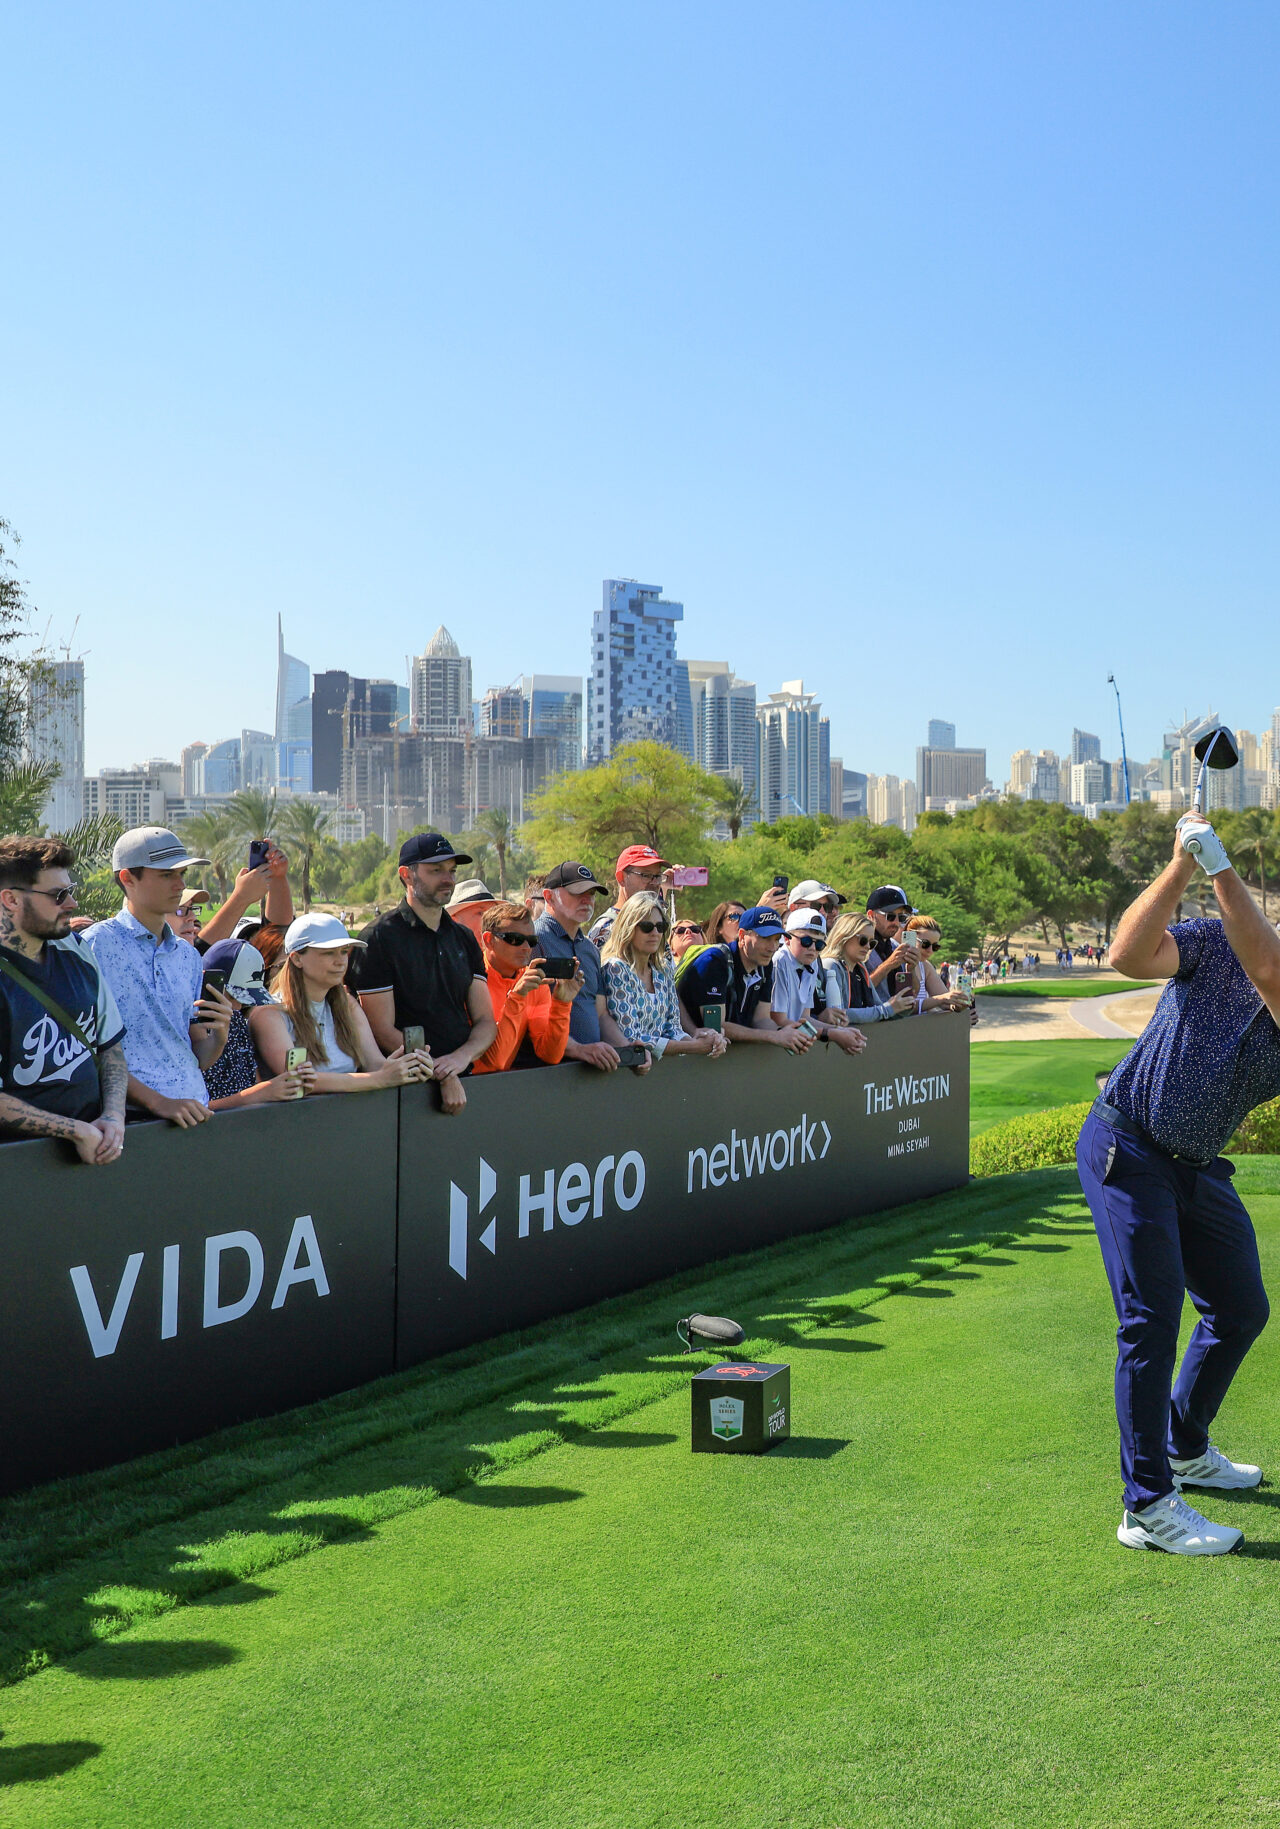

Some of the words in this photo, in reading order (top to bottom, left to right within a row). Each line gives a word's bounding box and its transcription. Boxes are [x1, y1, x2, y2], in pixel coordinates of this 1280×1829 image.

[894, 1073, 950, 1108] WESTIN
[898, 1116, 920, 1134] DUBAI
[687, 1113, 817, 1193] network
[887, 1142, 905, 1158] MINA
[906, 1135, 930, 1153] SEYAHI
[69, 1215, 330, 1358] VIDA
[768, 1414, 786, 1438] TOUR
